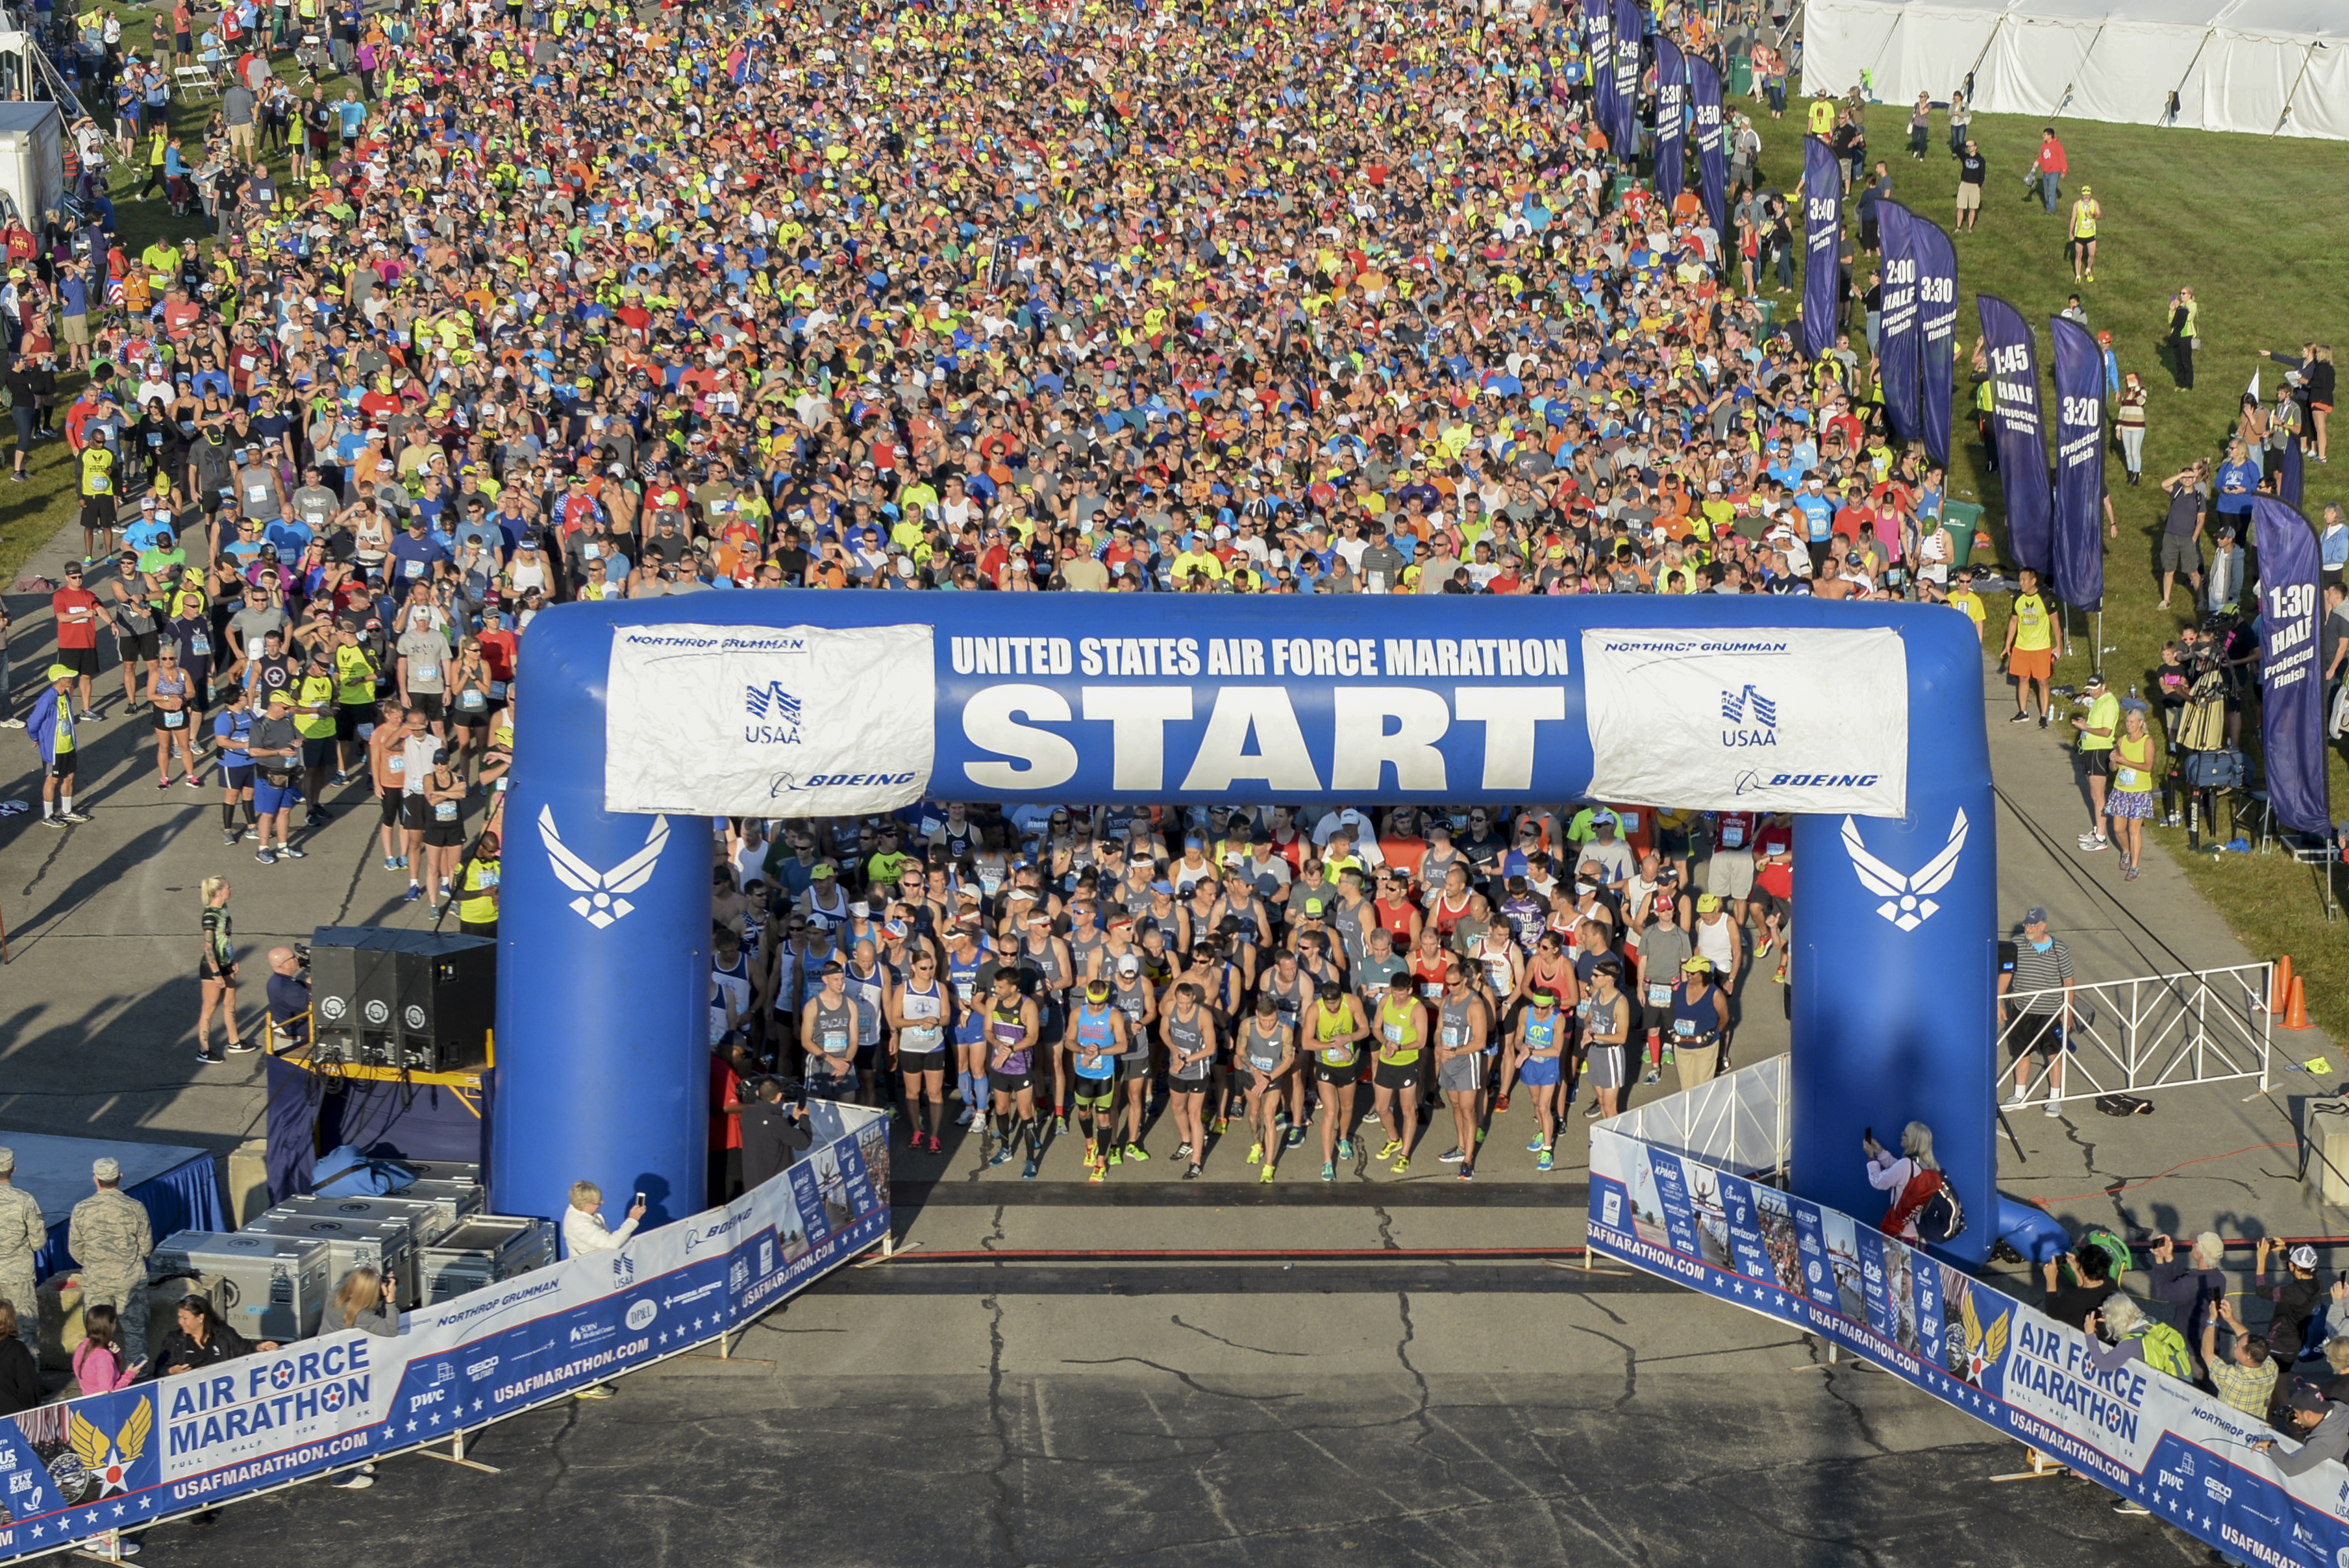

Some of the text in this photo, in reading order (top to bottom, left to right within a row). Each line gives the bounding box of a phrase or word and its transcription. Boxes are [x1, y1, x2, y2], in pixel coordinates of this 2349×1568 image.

[1589, 15, 1609, 33] 3:00
[1591, 33, 1610, 55] HALF
[1619, 40, 1638, 59] 2:45
[1618, 62, 1639, 79] HALF
[1615, 78, 1637, 90] Projecte
[1661, 84, 1682, 104] 2:30
[1658, 104, 1680, 124] HALF
[1697, 105, 1720, 125] 3:50
[1662, 129, 1678, 142] Finish
[1698, 126, 1722, 145] Projected
[1809, 197, 1835, 221] 3:40
[1886, 259, 1916, 284] 2:00
[1883, 286, 1915, 312] HALF
[1920, 276, 1953, 304] 3:30
[1882, 303, 1918, 329] Projected
[1887, 318, 1911, 338] Finish
[1923, 308, 1957, 332] Projected
[1928, 325, 1951, 342] Finish
[1991, 343, 2029, 375] 1:45
[1996, 380, 2033, 405] HALF
[2063, 396, 2099, 427] 3:20
[2006, 419, 2035, 435] Finish
[2069, 447, 2094, 468] Finish
[2269, 584, 2315, 619] 1:30
[626, 634, 805, 649] NORTHROP GRUMMAN
[1604, 642, 1787, 652] NORTHROP GRUMMAN
[2271, 616, 2312, 656] HALF
[951, 636, 1569, 677] UNITED STATES AIR FORCE MARATHON
[2264, 645, 2314, 680] Projected
[2274, 666, 2306, 690] Finish
[745, 726, 801, 744] USAA
[961, 683, 1566, 791] START
[1722, 729, 1777, 747] USAA
[805, 772, 916, 787] BOEING
[1769, 774, 1880, 787] BOEING
[1654, 1165, 1677, 1181] KPMG
[706, 1208, 752, 1239] BOEING
[1730, 1226, 1756, 1242] verizon
[1587, 1223, 1704, 1281] SAFMARATHON.COM
[1738, 1244, 1760, 1258] meijer
[741, 1240, 835, 1308] USAFMARATHON.COM
[1863, 1260, 1882, 1280] Dole
[614, 1275, 634, 1290] USAA
[437, 1278, 560, 1328] NORTHROP GRUMMAN
[630, 1305, 653, 1325] DP&L
[1809, 1306, 1920, 1376] USAFMARATHON.COM
[466, 1356, 499, 1376] GEICO
[493, 1338, 649, 1404] USAFMARATHON.COM
[2019, 1321, 2147, 1408] AIR FORCE
[171, 1338, 370, 1420] AIR FORCE
[410, 1389, 445, 1413] pwc
[2011, 1353, 2139, 1444] MARATHON
[169, 1374, 370, 1457] MARATHON
[2010, 1388, 2133, 1458] FULL HALF 10K 5K
[2191, 1406, 2244, 1437] NORTHROP
[171, 1410, 370, 1470] FULL HALF 10K 5K
[2010, 1410, 2130, 1486] USAFMARATHON.COM
[173, 1432, 368, 1500] USAFMARATHON.COM
[10, 1484, 32, 1494] ZONE
[2158, 1469, 2184, 1491] pwc
[2204, 1476, 2232, 1499] GEICO
[2335, 1503, 2349, 1520] USA
[2221, 1524, 2306, 1568] USAFMARAT
